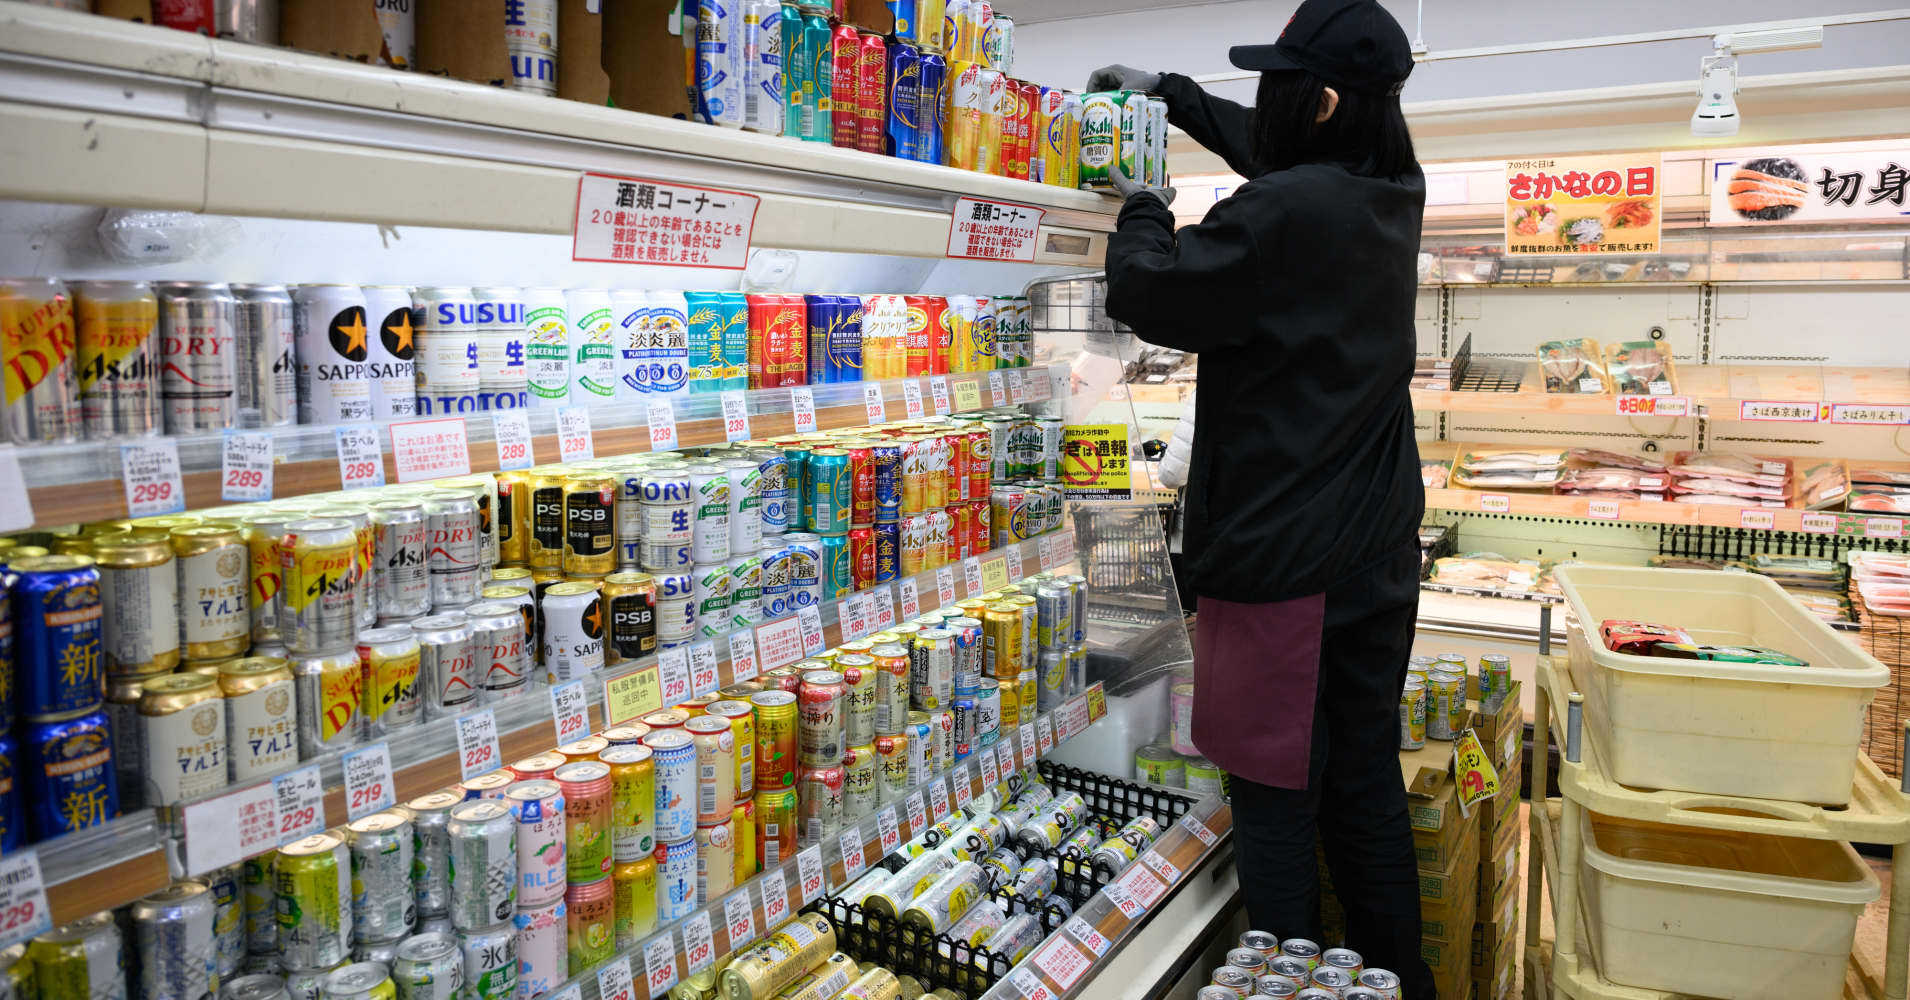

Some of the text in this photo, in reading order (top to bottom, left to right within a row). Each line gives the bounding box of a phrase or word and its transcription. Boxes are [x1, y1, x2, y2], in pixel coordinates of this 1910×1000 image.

[1081, 114, 1113, 136] Asahi
[1508, 160, 1555, 169] 7の付く日は
[1509, 167, 1655, 200] さかなの日
[1815, 162, 1910, 207] 切身
[615, 182, 727, 213] 酒類コーナー
[971, 203, 1026, 223] 酒類コーナー
[591, 209, 742, 236] 20歳以上の年齢であることを
[613, 228, 722, 249] 確認できない場合には
[968, 234, 1022, 249] 確認できない場合には
[611, 244, 710, 264] 酒類を販売しません
[966, 245, 1015, 258] 酒類を販売しません
[788, 321, 804, 359] 金麦
[506, 340, 524, 366] 生
[869, 405, 881, 417] 239
[908, 402, 920, 413] 239
[936, 398, 947, 409] 239
[1752, 406, 1811, 418] さば西京漬け
[728, 419, 745, 433] 239
[797, 413, 812, 425] 239
[653, 427, 671, 442] 239
[502, 443, 525, 460] 289
[565, 438, 586, 453] 239
[345, 462, 375, 480] 289
[1100, 459, 1127, 469] します
[226, 470, 263, 487] 289
[133, 482, 172, 504] 299
[569, 509, 606, 521] PSB
[671, 508, 689, 532] 生
[967, 581, 979, 592] 189
[941, 590, 952, 601] 189
[903, 602, 916, 615] 189
[615, 612, 652, 625] PSB
[877, 611, 892, 624] 189
[850, 620, 865, 633] 189
[805, 632, 820, 648] 189
[61, 640, 100, 687] 新
[735, 657, 753, 674] 189
[695, 670, 713, 688] 219
[665, 680, 685, 698] 219
[560, 714, 583, 736] 229
[1040, 736, 1051, 749] 199
[465, 745, 492, 768] 229
[1023, 746, 1034, 759] 199
[1001, 760, 1012, 773] 199
[984, 771, 995, 786] 119
[277, 778, 316, 799] 生ビール
[351, 783, 382, 809] 219
[957, 787, 969, 802] 139
[63, 784, 110, 832] 新
[934, 801, 947, 817] 149
[280, 807, 315, 834] 229
[910, 814, 924, 831] 149
[883, 831, 897, 848] 149
[845, 853, 860, 871] 149
[1160, 865, 1174, 879] 179
[804, 876, 820, 894] 139
[767, 898, 784, 918] 139
[1121, 900, 1136, 914] 179
[731, 919, 749, 940] 139
[688, 943, 709, 966] 139
[650, 964, 672, 988] 139
